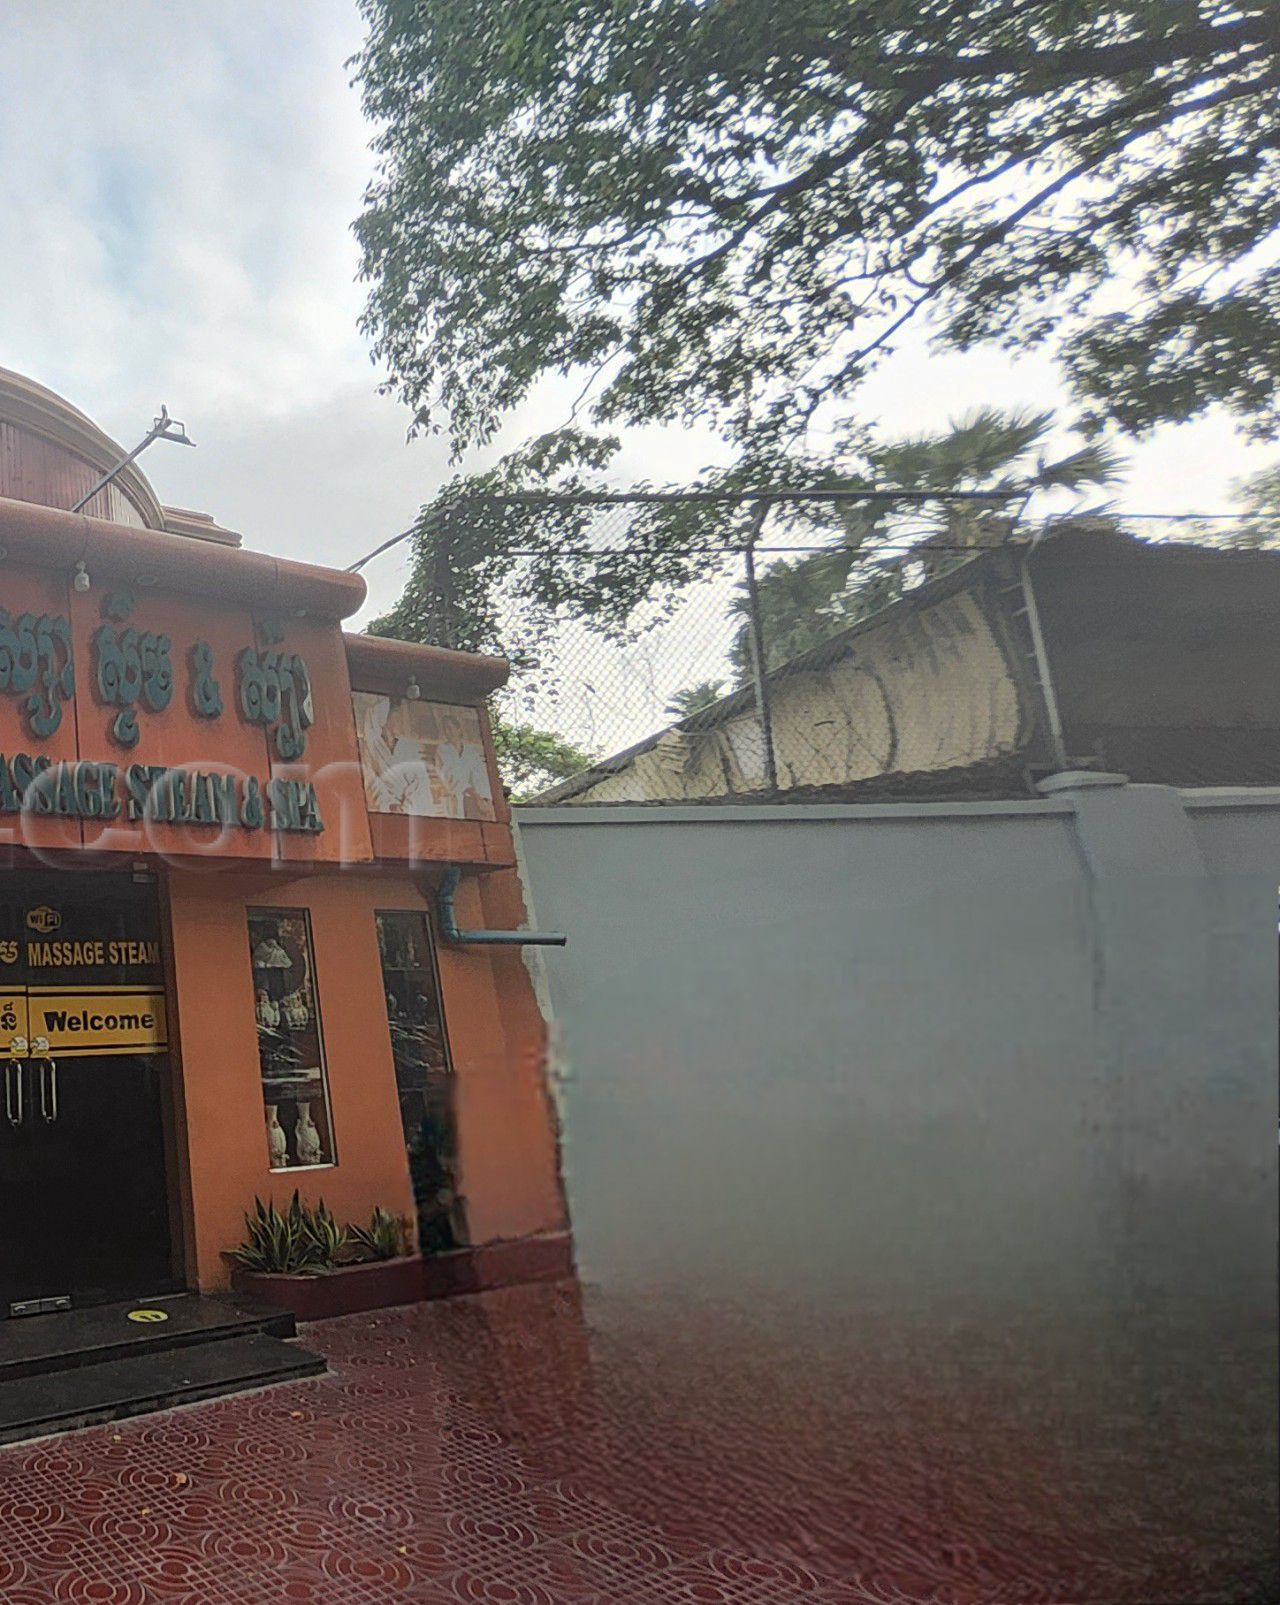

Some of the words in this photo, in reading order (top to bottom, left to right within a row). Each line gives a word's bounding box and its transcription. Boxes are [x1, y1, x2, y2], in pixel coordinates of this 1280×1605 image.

[193, 641, 224, 718] &
[125, 763, 241, 828] STEAM
[241, 775, 264, 829] &
[267, 776, 325, 833] SPA
[27, 942, 105, 967] MASSAGE
[108, 942, 160, 965] STEAM
[43, 1010, 154, 1033] Welcome
